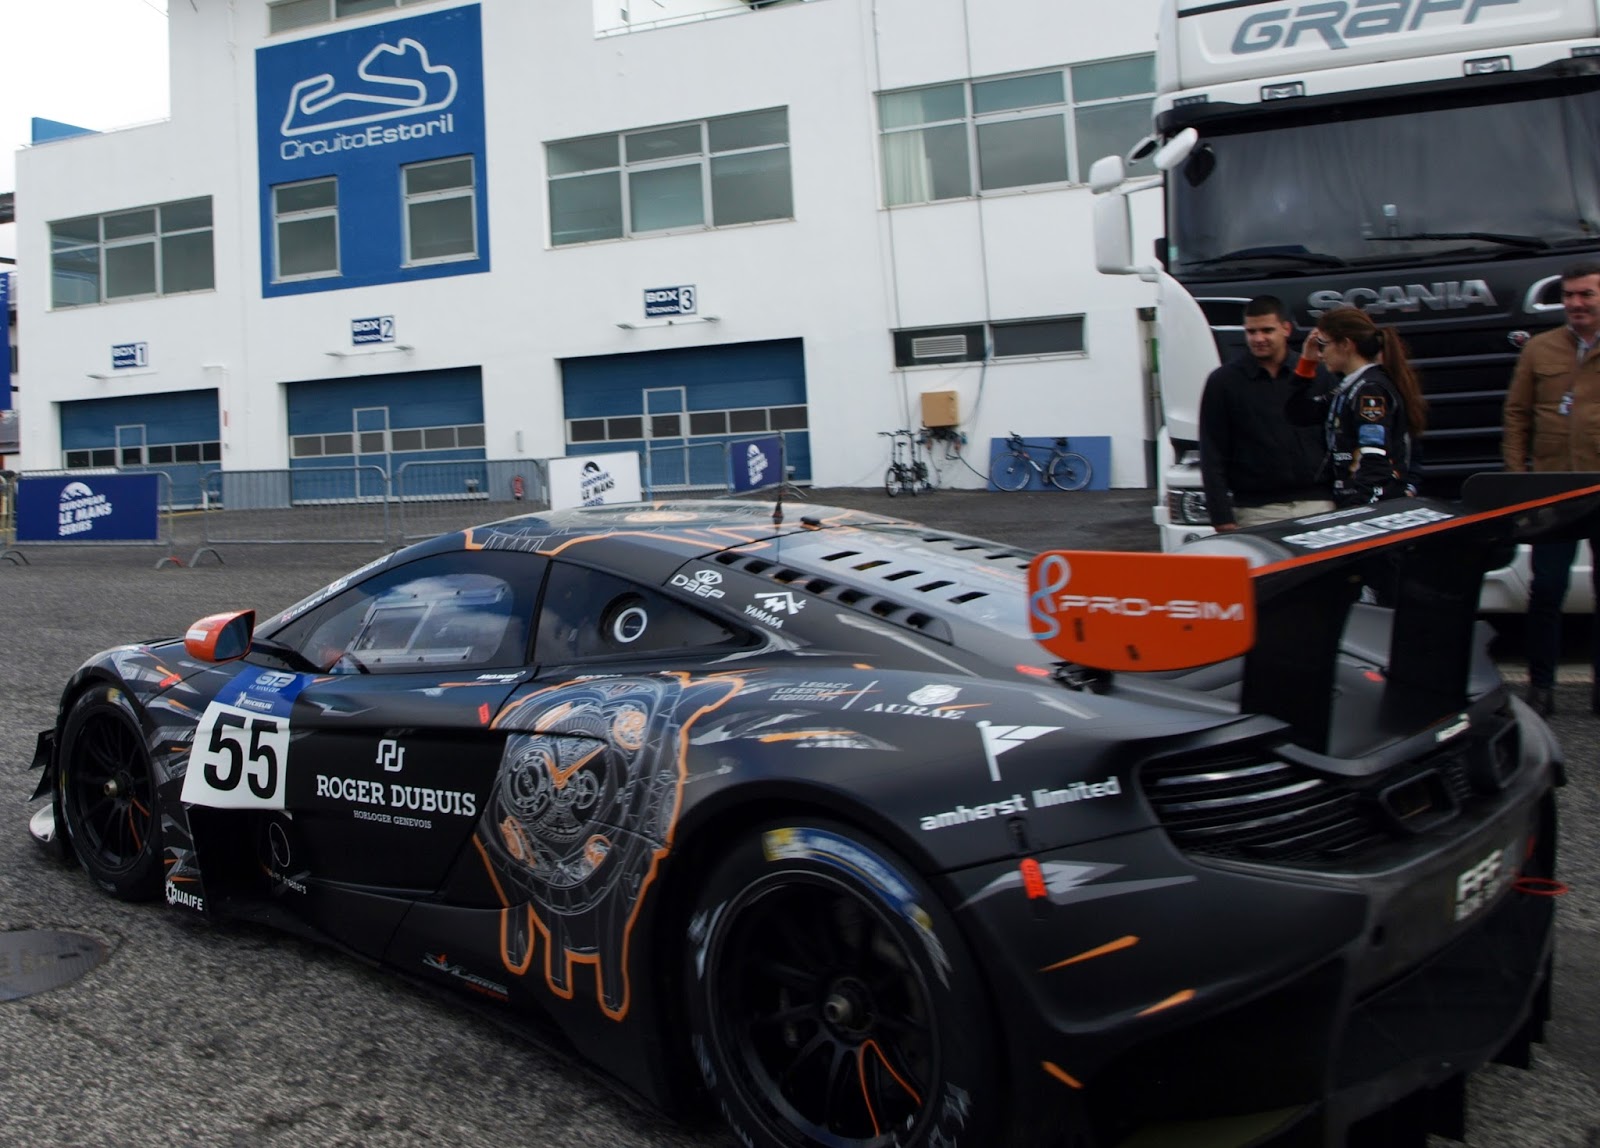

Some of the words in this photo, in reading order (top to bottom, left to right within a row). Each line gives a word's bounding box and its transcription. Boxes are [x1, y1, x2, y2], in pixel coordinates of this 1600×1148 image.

[646, 290, 679, 303] BOX
[682, 289, 693, 310] 3
[1306, 279, 1498, 318] SCANIA
[353, 320, 380, 332] BOX
[384, 319, 393, 338] 2
[59, 494, 106, 512] EUROPEAN
[59, 511, 73, 525] LE
[75, 502, 113, 521] MANS
[58, 519, 93, 536] SERIES
[744, 604, 784, 629] YAMASA
[1058, 594, 1245, 621] PRO-SIM
[255, 670, 297, 688] GT3
[798, 681, 853, 689] LEGACY
[243, 698, 273, 710] MICHELIN
[203, 711, 278, 800] 55
[316, 774, 386, 806] ROGER
[390, 784, 477, 817] DUBUIS
[919, 794, 1029, 831] amherst
[1032, 776, 1122, 808] limited
[353, 809, 392, 824] HORLOGER
[393, 816, 432, 829] GENEVOIS
[165, 879, 204, 911] QUAIFE
